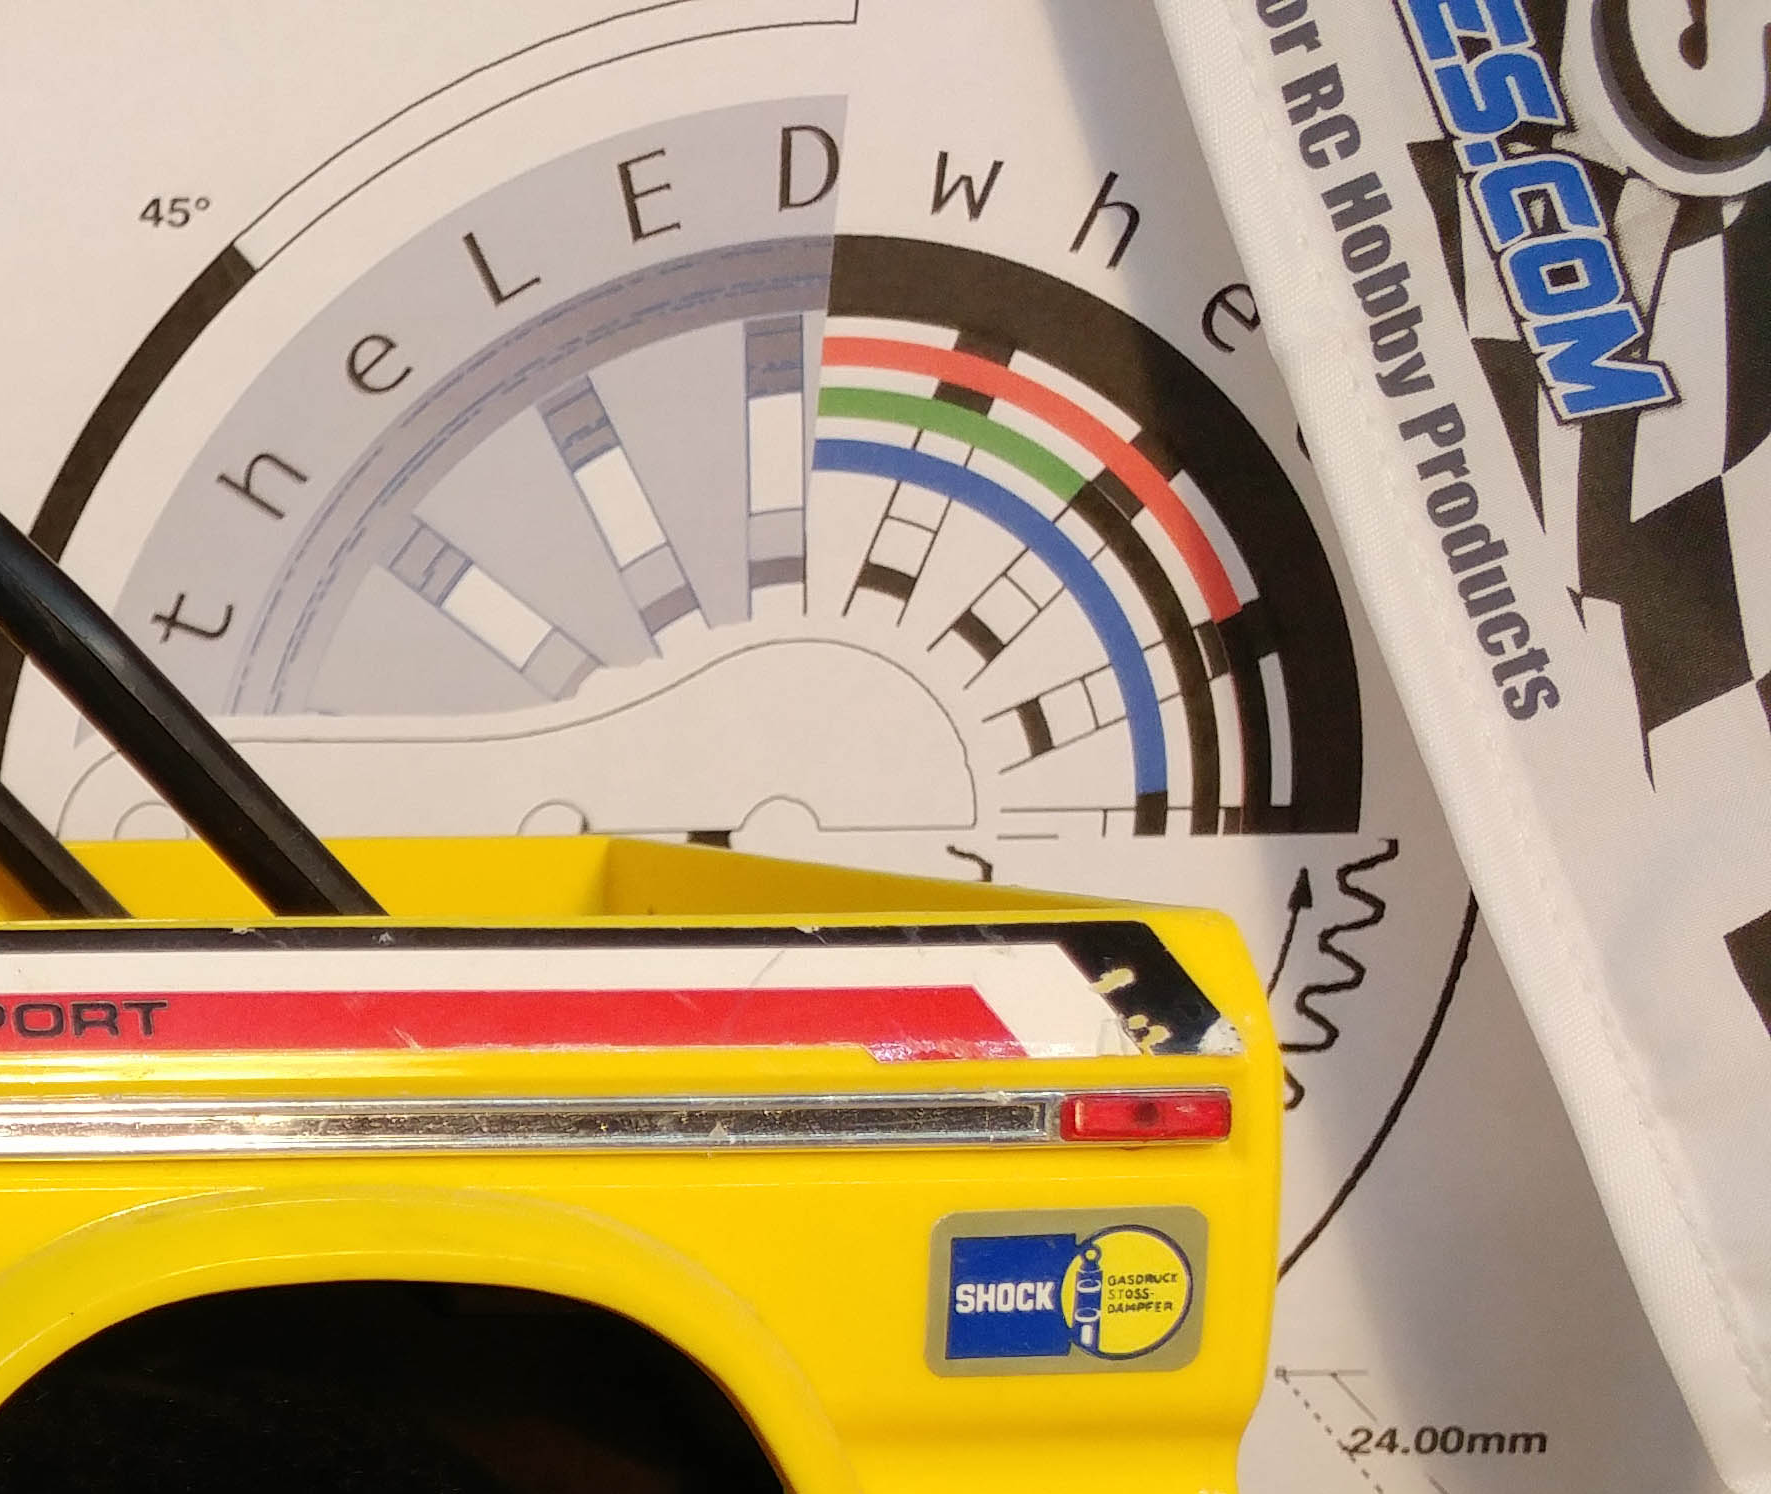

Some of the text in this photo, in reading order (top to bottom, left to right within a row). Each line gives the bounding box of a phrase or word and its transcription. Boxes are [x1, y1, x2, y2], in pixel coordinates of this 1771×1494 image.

[1281, 62, 1362, 169] RC
[1321, 171, 1436, 398] Hobby
[1399, 402, 1561, 721] Products
[955, 1281, 1056, 1314] SHOCK
[1349, 1425, 1549, 1457] 24.00mm
